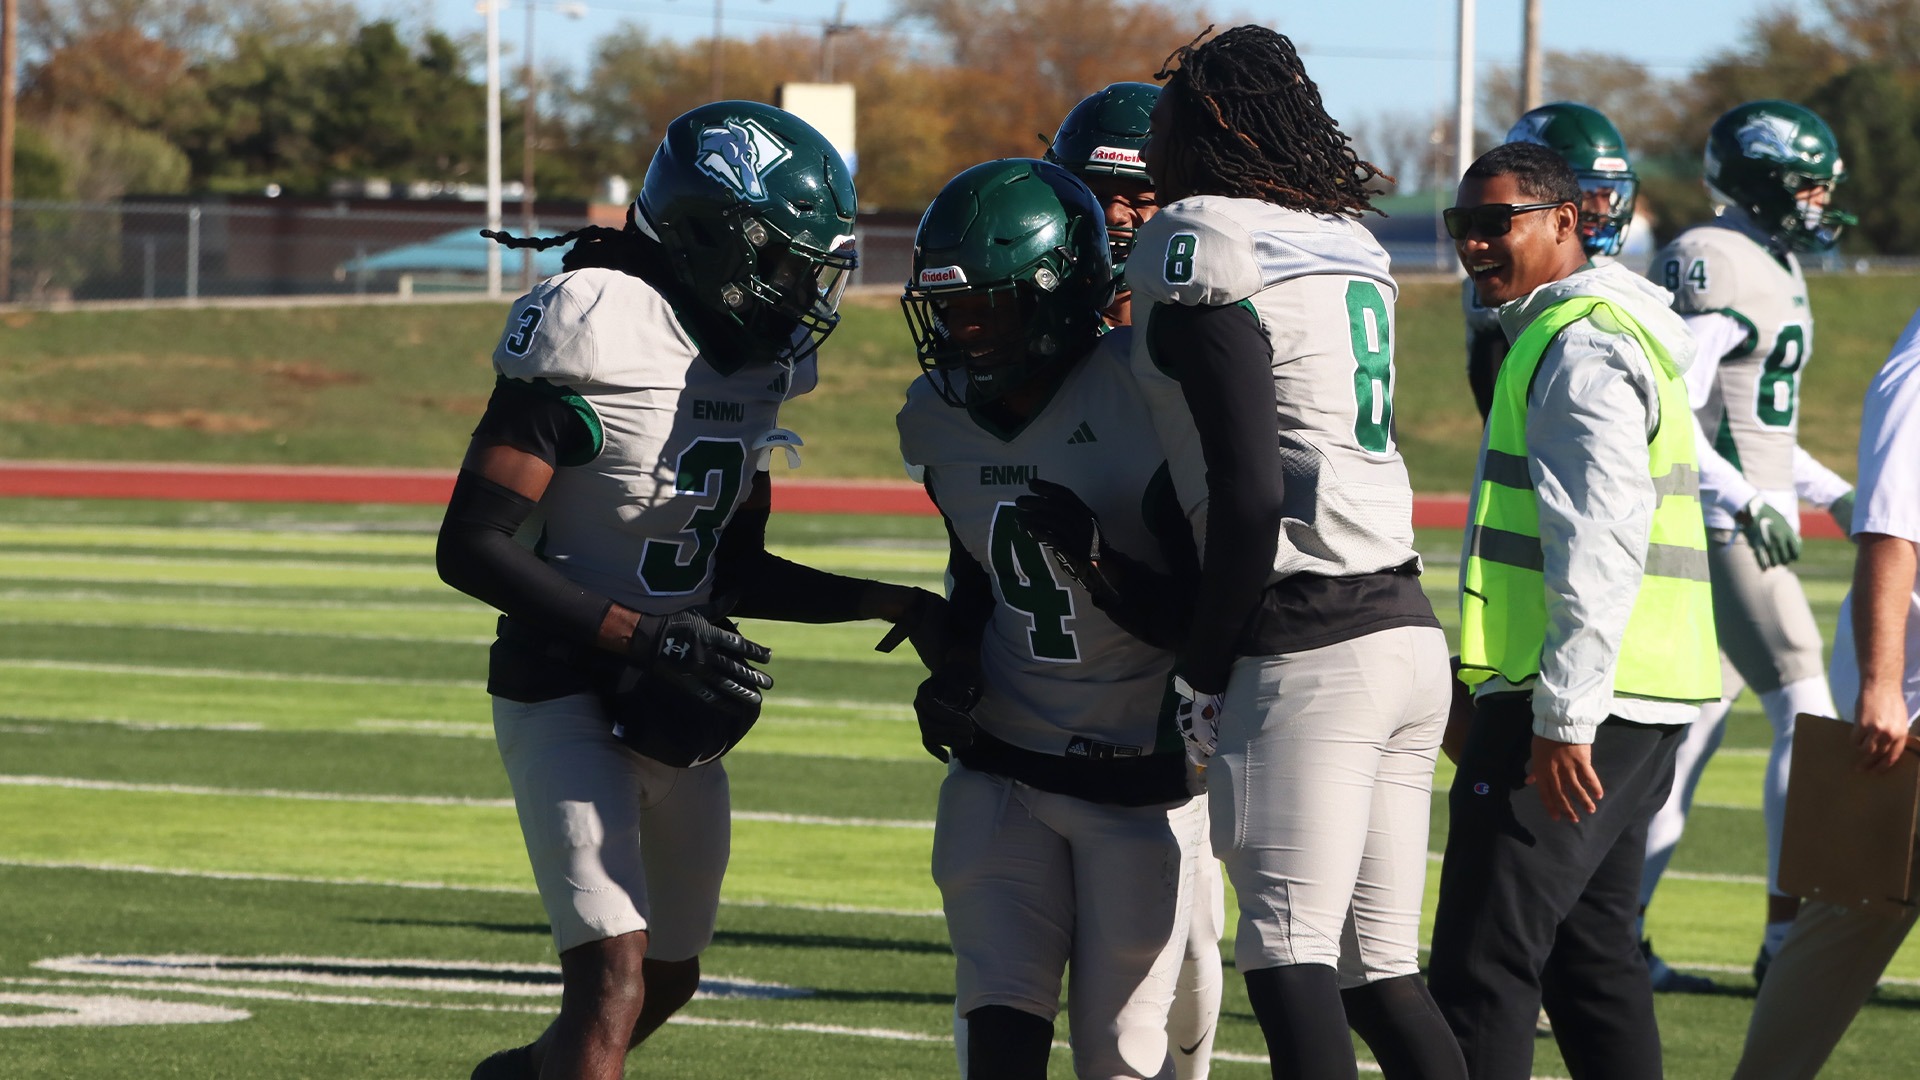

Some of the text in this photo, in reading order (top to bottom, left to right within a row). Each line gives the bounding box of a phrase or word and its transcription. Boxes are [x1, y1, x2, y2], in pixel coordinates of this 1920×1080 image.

[921, 269, 957, 283] Riddell
[1163, 232, 1200, 286] 8
[1663, 255, 1710, 294] 84
[505, 304, 544, 359] 3
[1345, 277, 1397, 457] 8
[693, 399, 745, 423] ENMU
[980, 465, 1039, 486] ENMU
[637, 436, 747, 596] 3
[987, 501, 1082, 662] 4
